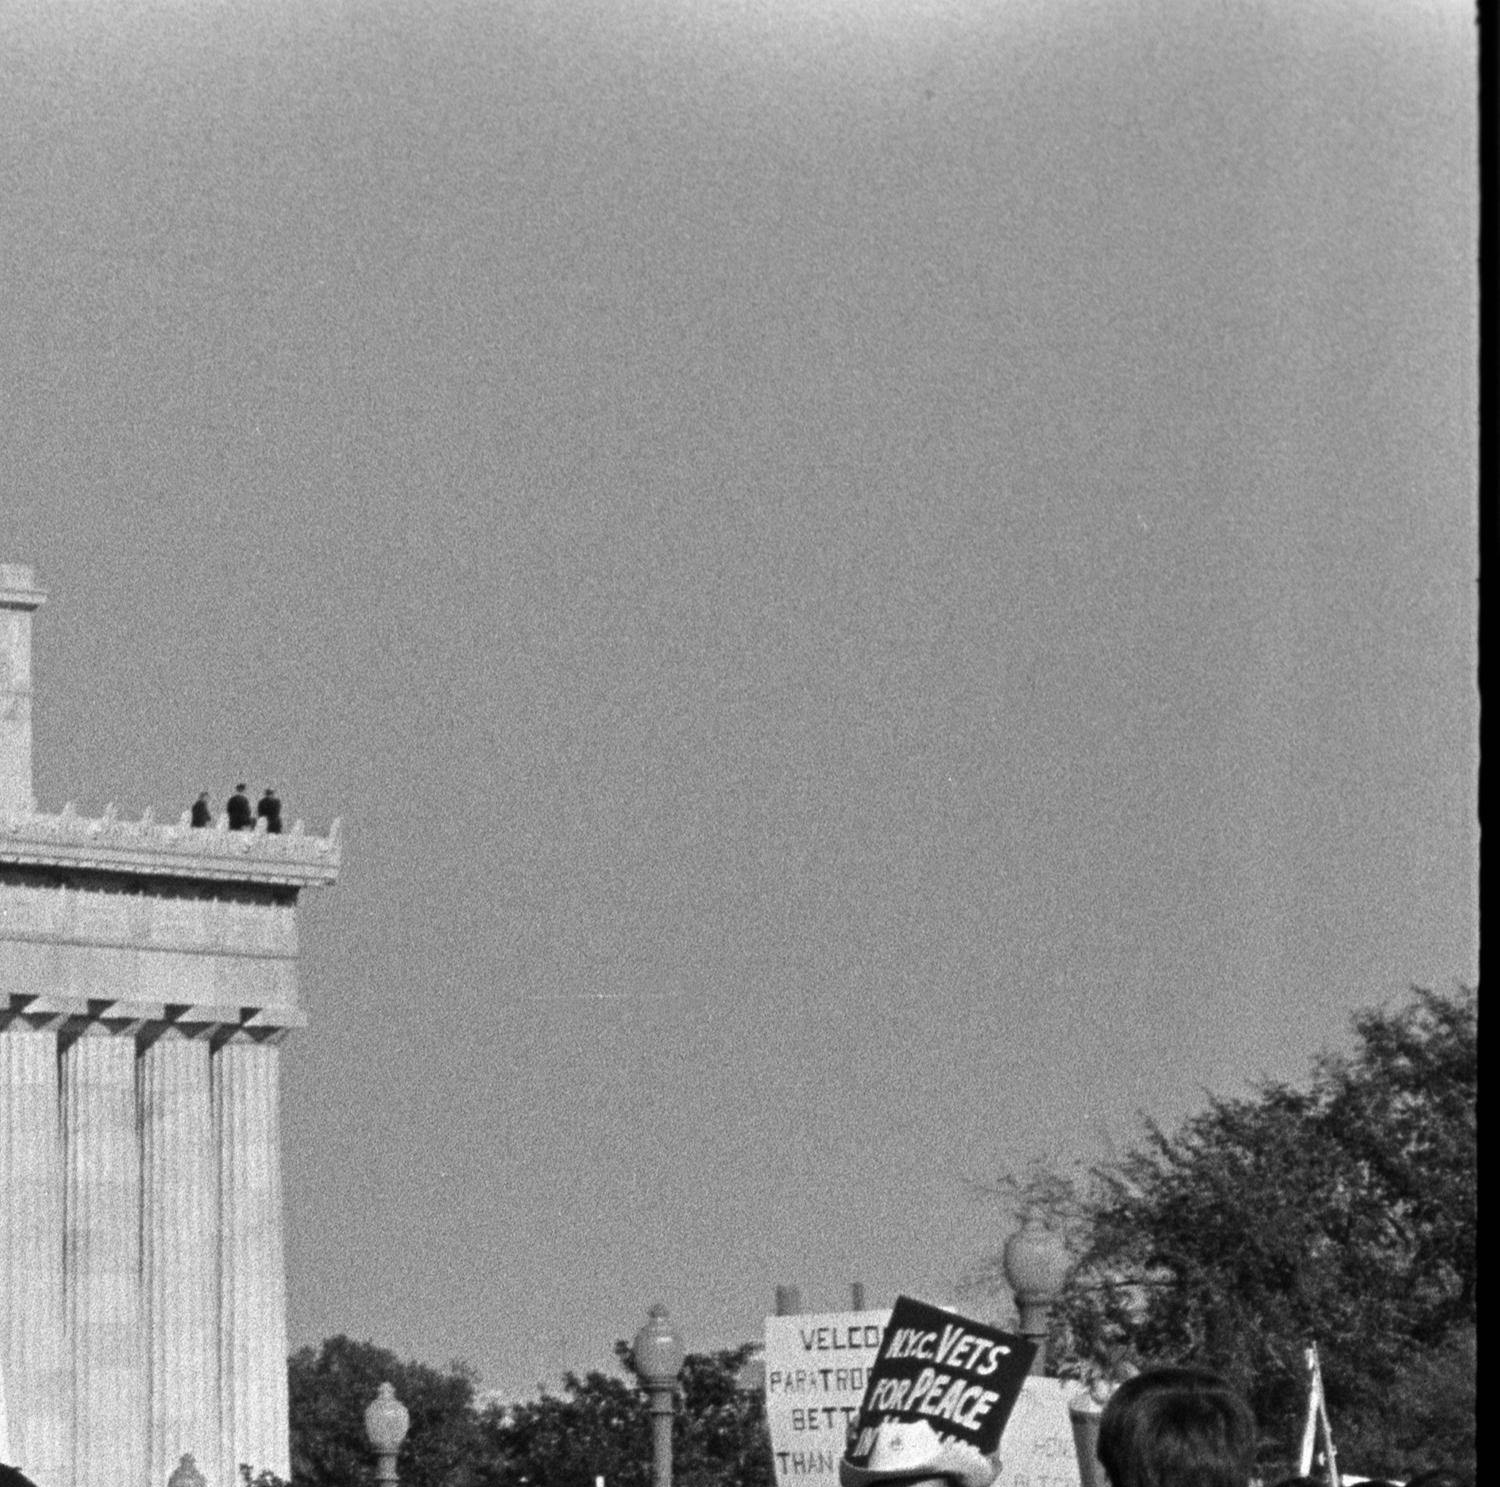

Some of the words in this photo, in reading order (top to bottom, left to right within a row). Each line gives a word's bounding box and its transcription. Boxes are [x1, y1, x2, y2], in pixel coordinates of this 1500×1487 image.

[799, 1325, 882, 1351] VELCO
[933, 1324, 1012, 1376] VETS
[769, 1367, 868, 1394] PARATRO
[868, 1376, 910, 1411] FOR
[906, 1367, 1000, 1431] PEACE
[791, 1405, 857, 1432] BETT
[774, 1451, 834, 1476] THAN
